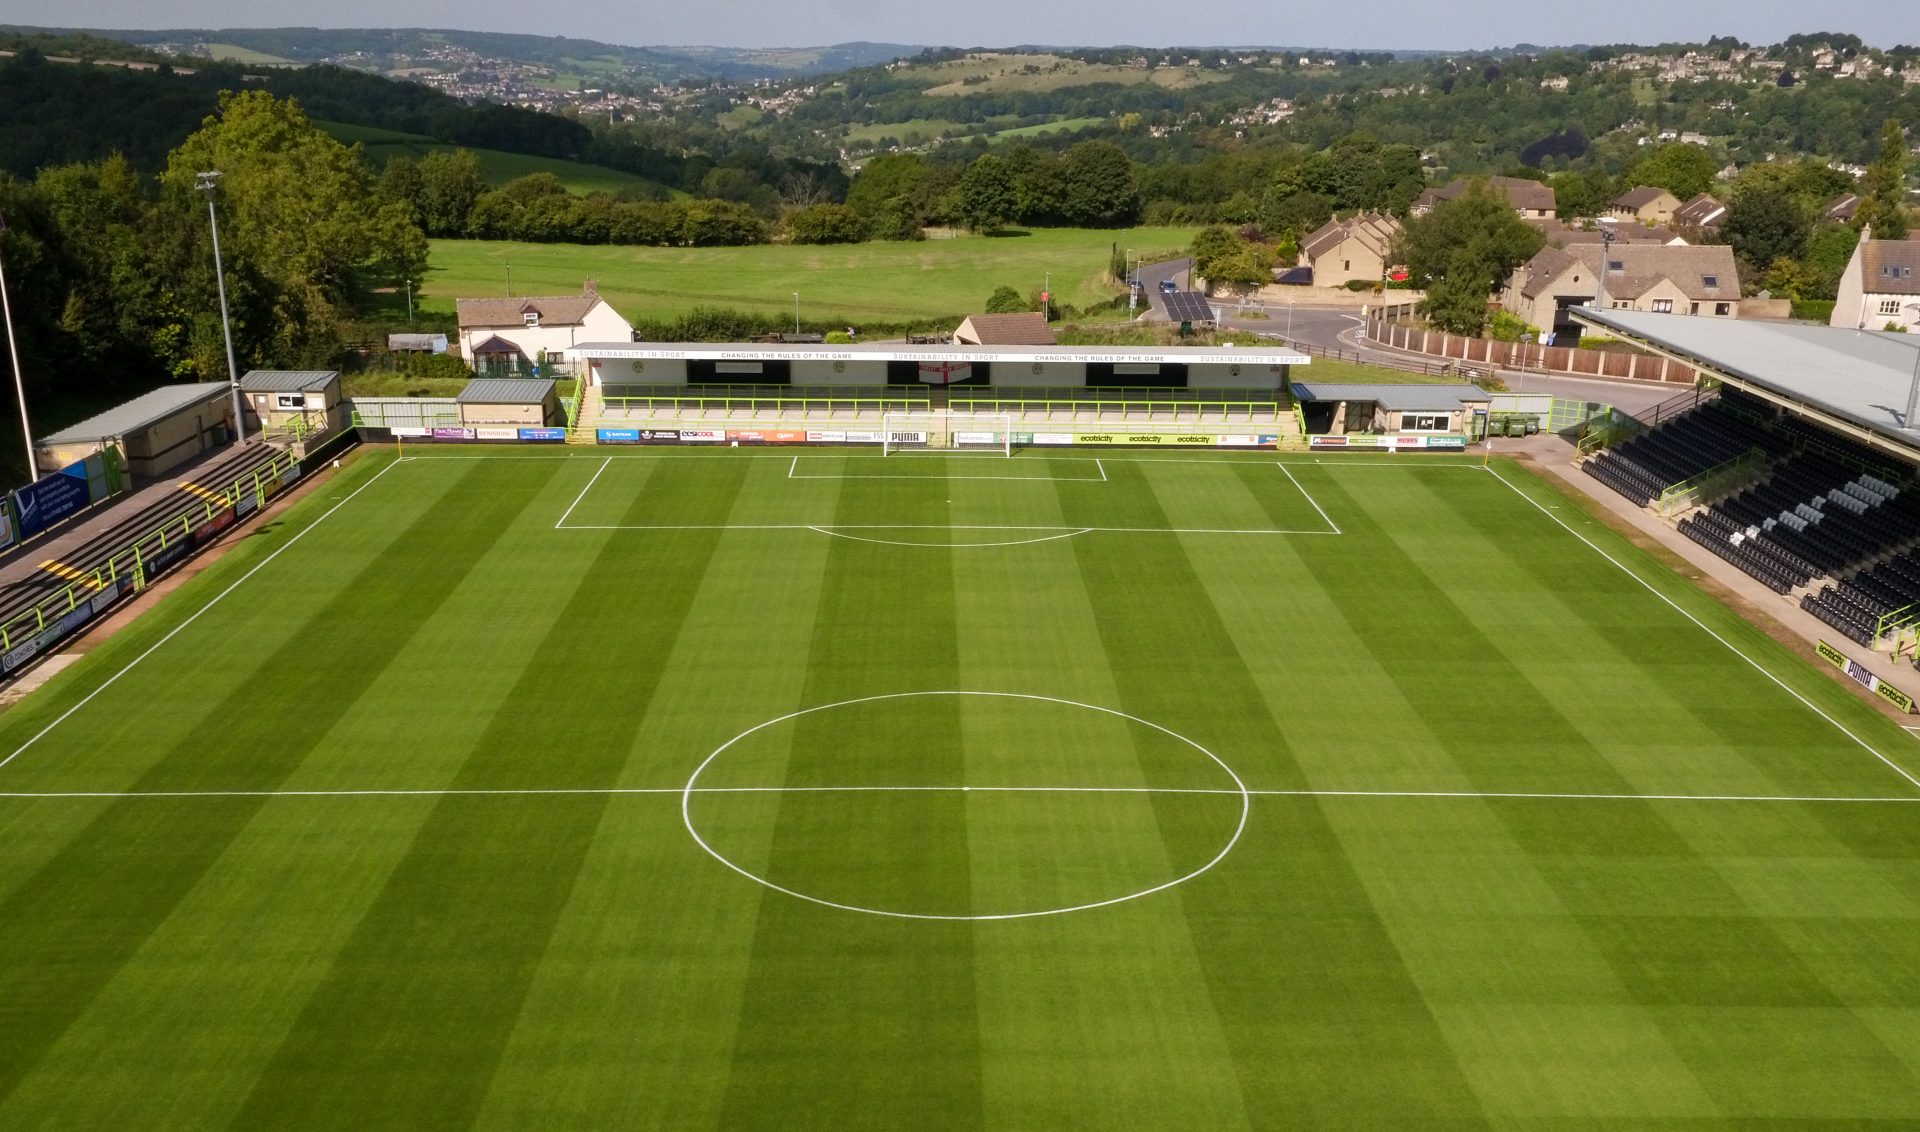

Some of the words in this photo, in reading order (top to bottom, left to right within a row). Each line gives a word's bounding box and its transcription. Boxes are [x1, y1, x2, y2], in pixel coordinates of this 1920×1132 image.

[579, 350, 643, 358] SUSTAINABILITY
[1200, 355, 1263, 363] SUSTAINABILITY
[1280, 356, 1305, 364] SPORT
[891, 432, 919, 441] PUMA
[1080, 435, 1113, 443] ecotricity
[1129, 435, 1161, 443] ecotricity
[1177, 436, 1210, 444] ecotricity
[1818, 644, 1844, 667] ecotricity
[1847, 661, 1873, 687] PUMA
[1878, 684, 1908, 709] ecotricity
